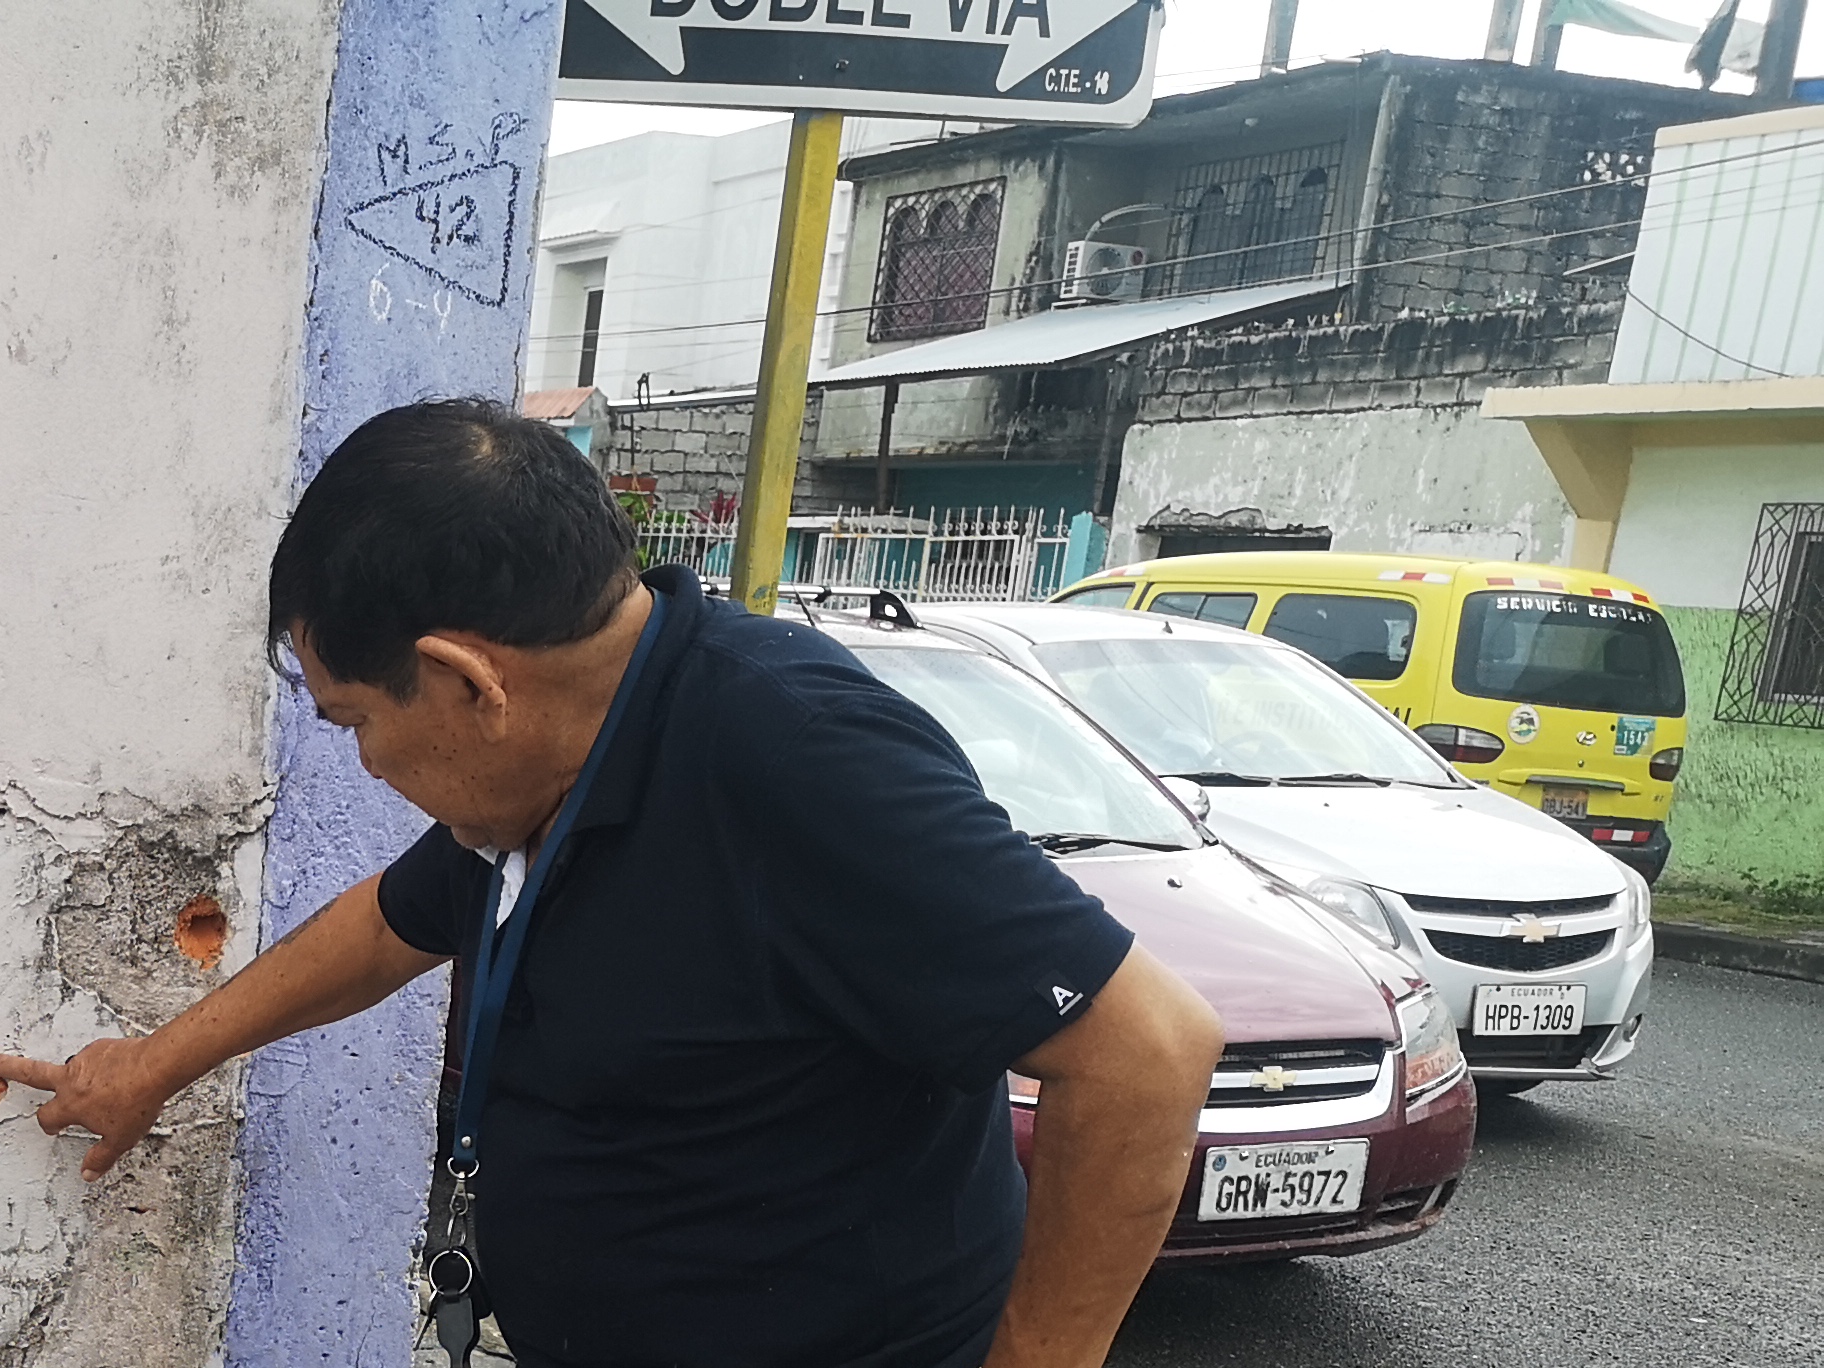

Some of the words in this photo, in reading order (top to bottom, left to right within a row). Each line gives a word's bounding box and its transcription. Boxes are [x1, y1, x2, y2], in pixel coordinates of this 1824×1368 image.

[1044, 67, 1082, 93] C.T.E.
[1511, 987, 1554, 997] ECUADOR
[1485, 1004, 1574, 1031] HPB-1309
[1254, 1151, 1319, 1168] ECUADOR
[1215, 1169, 1348, 1214] GRW-5972
